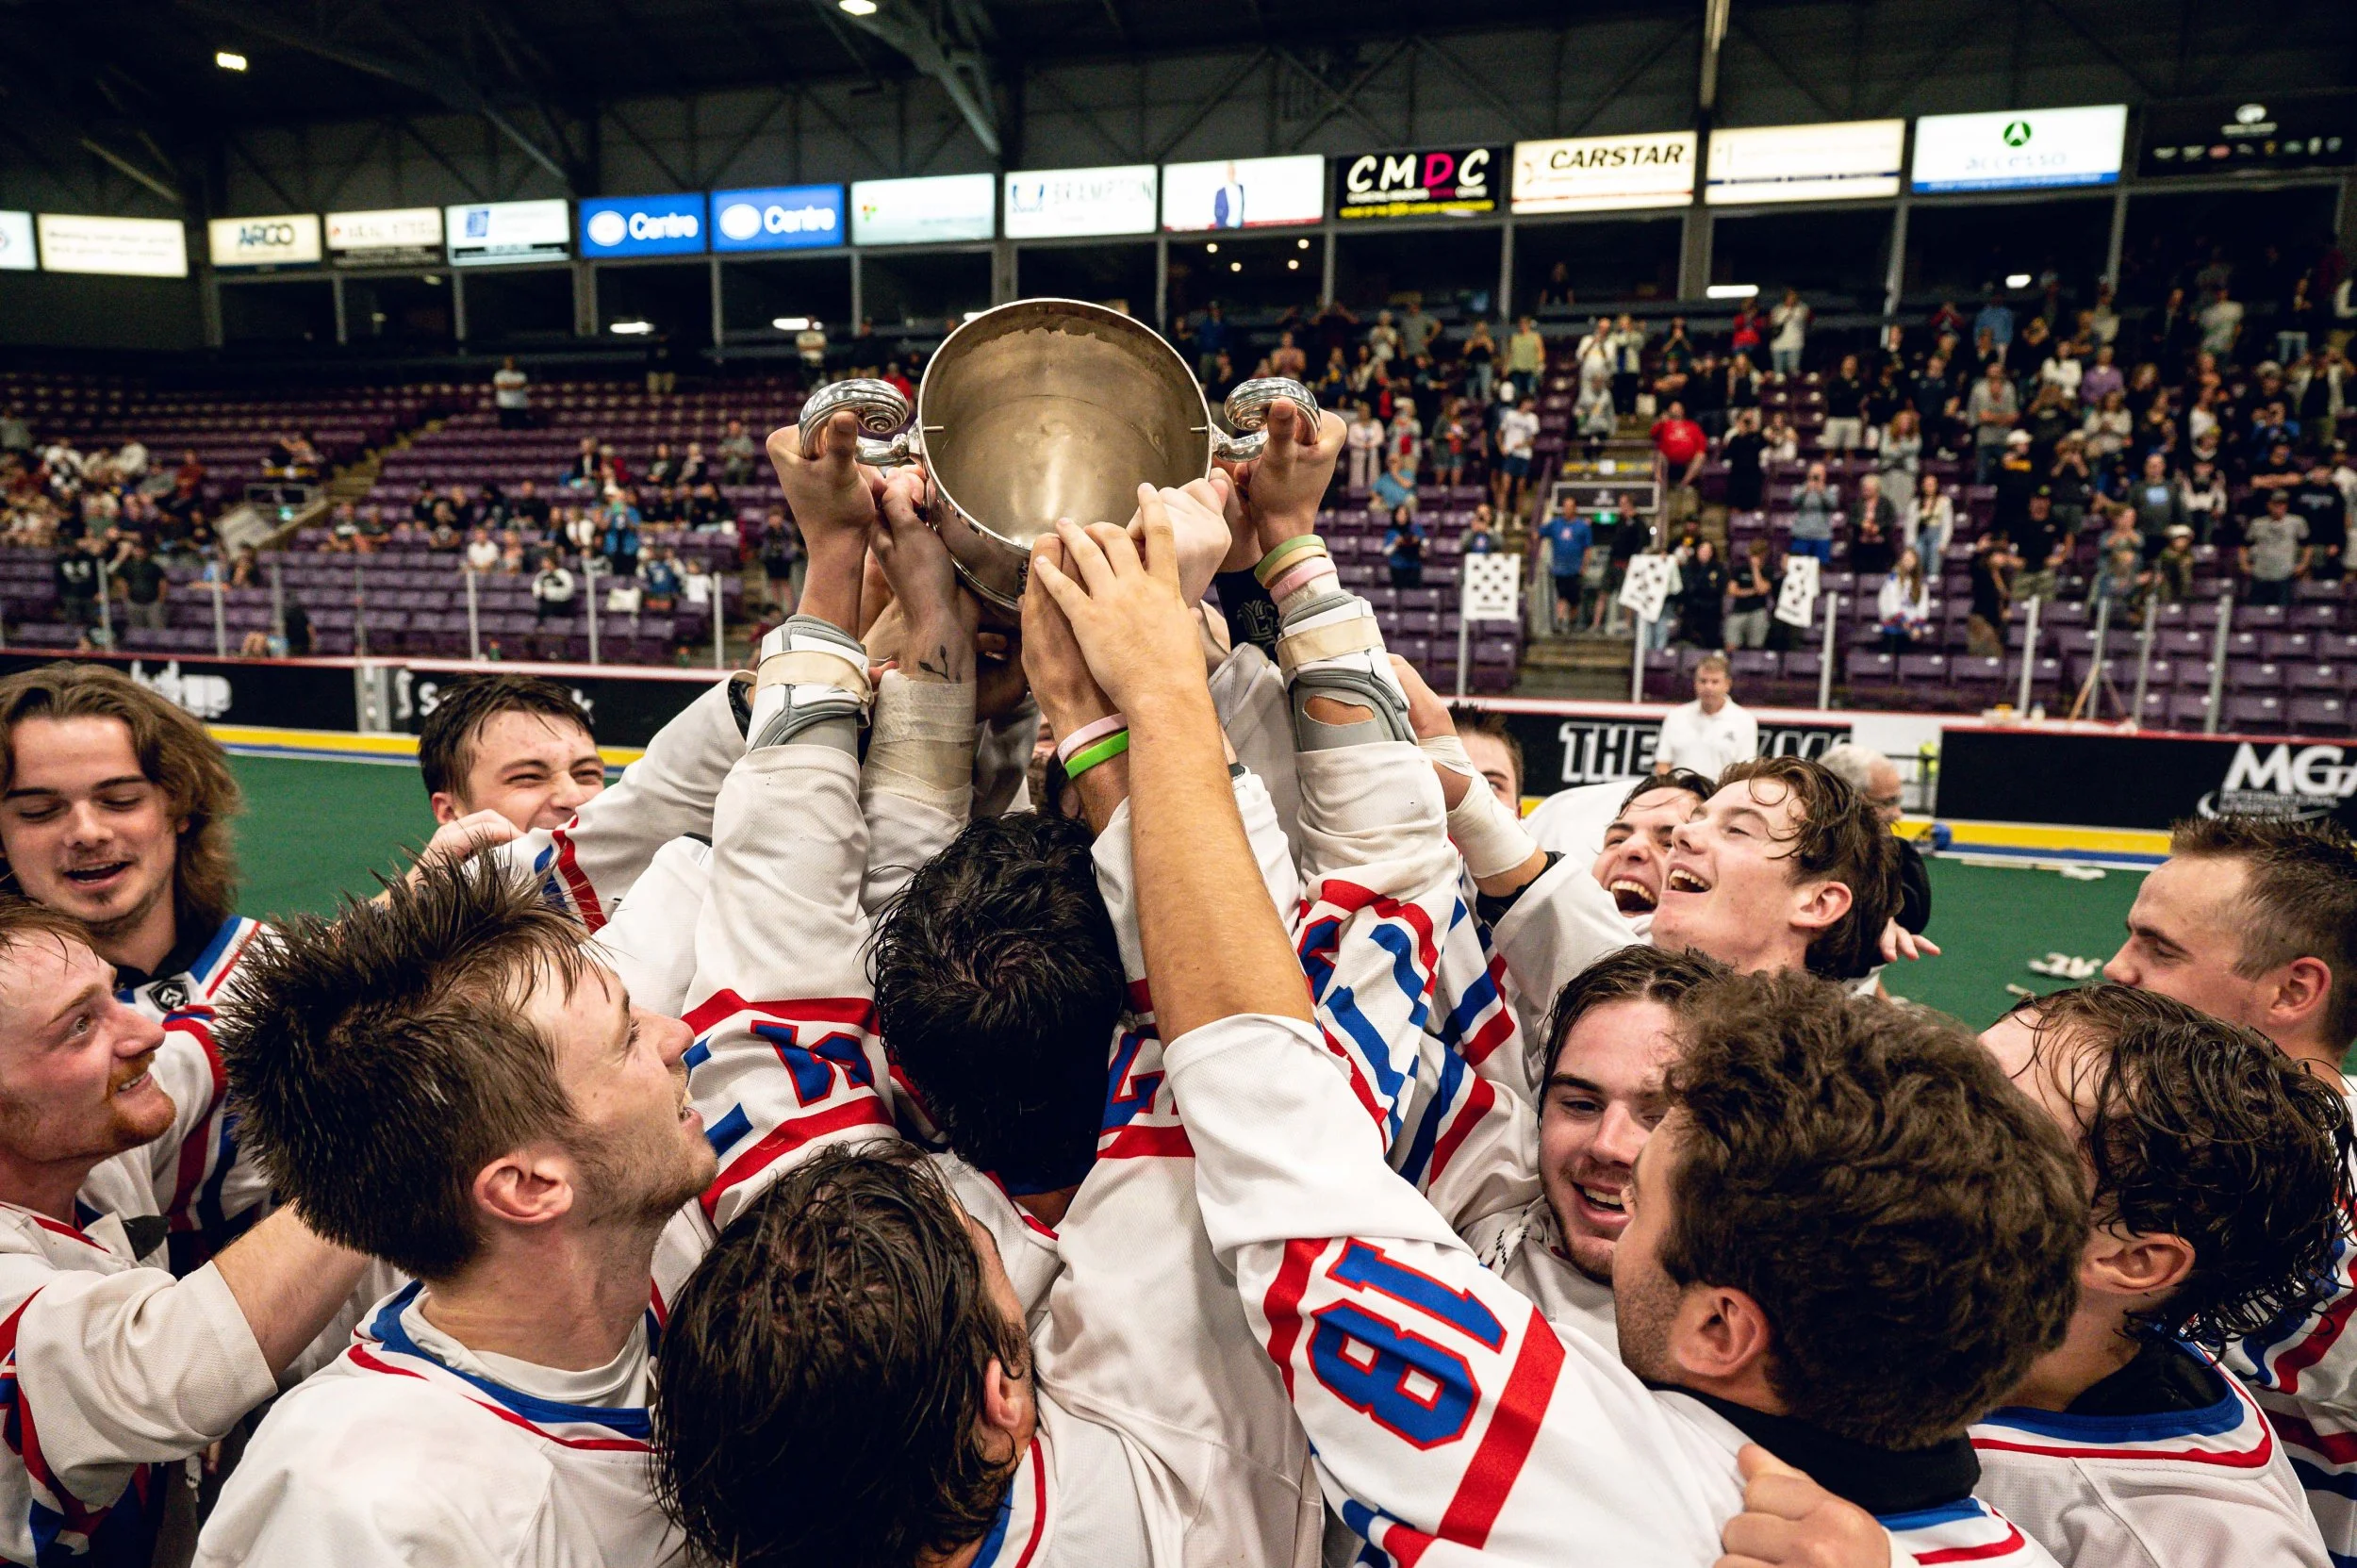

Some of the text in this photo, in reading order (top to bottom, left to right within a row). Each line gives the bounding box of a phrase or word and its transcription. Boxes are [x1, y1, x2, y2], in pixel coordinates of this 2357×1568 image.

[1347, 148, 1491, 193] CMDC
[1549, 142, 1687, 171] CARSTAR
[628, 211, 699, 240] Centre
[764, 204, 836, 234] Centre
[1558, 720, 1661, 783] THE
[1306, 1235, 1508, 1452] 18
